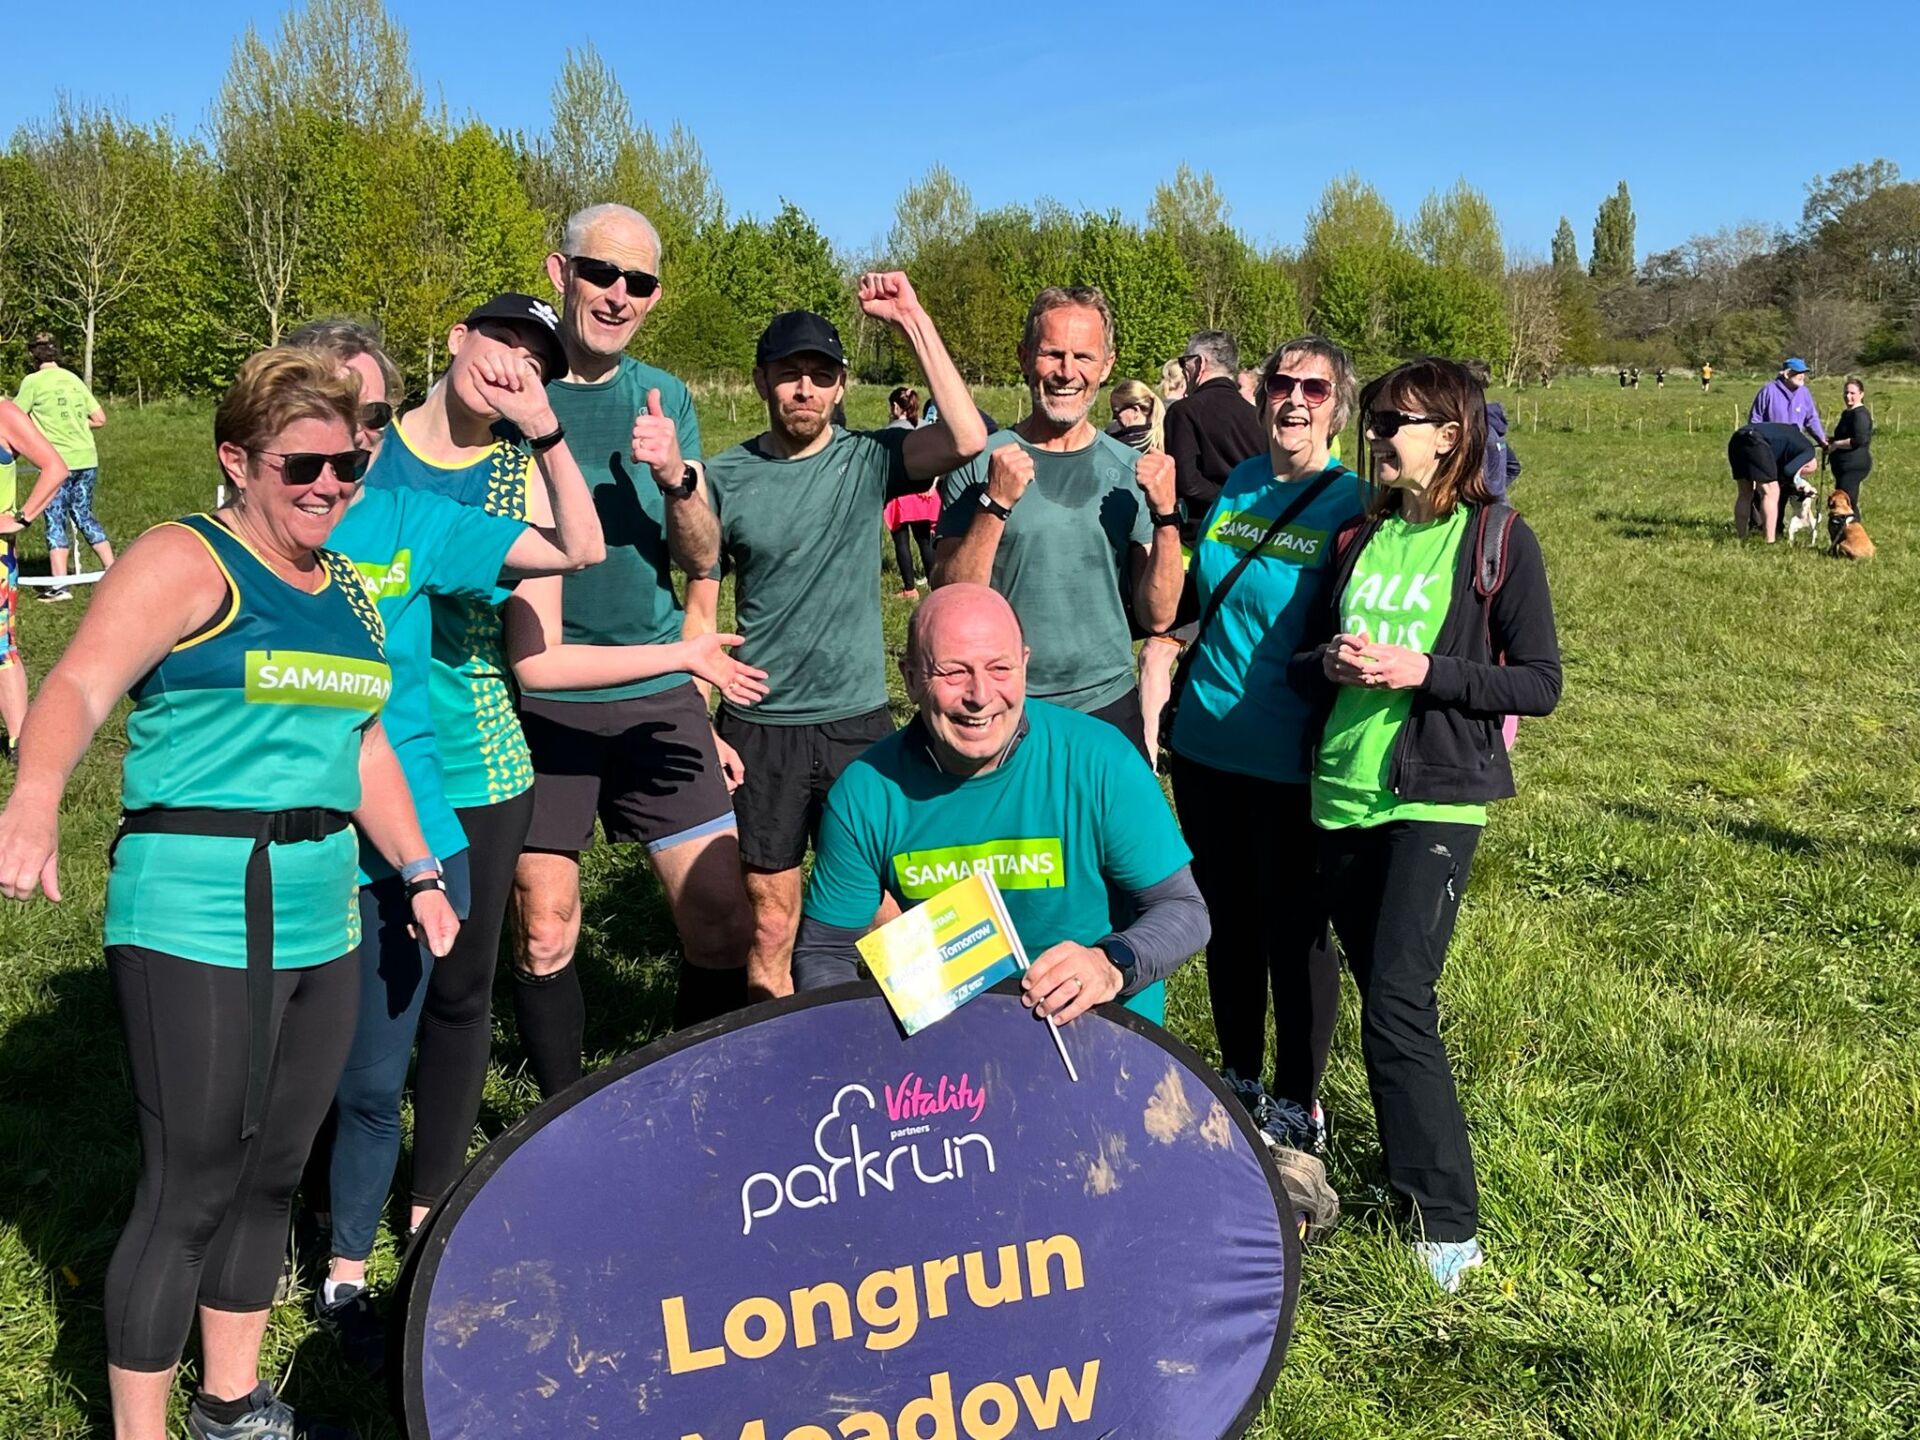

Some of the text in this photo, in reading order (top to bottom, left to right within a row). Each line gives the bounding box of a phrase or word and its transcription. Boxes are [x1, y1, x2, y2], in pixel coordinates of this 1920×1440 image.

[1350, 569, 1440, 612] ALK
[939, 924, 991, 959] Tomorrow
[884, 1072, 985, 1122] Vitality
[890, 1124, 930, 1141] partners
[741, 1122, 996, 1235] parkrun
[661, 1233, 1086, 1375] Longrun
